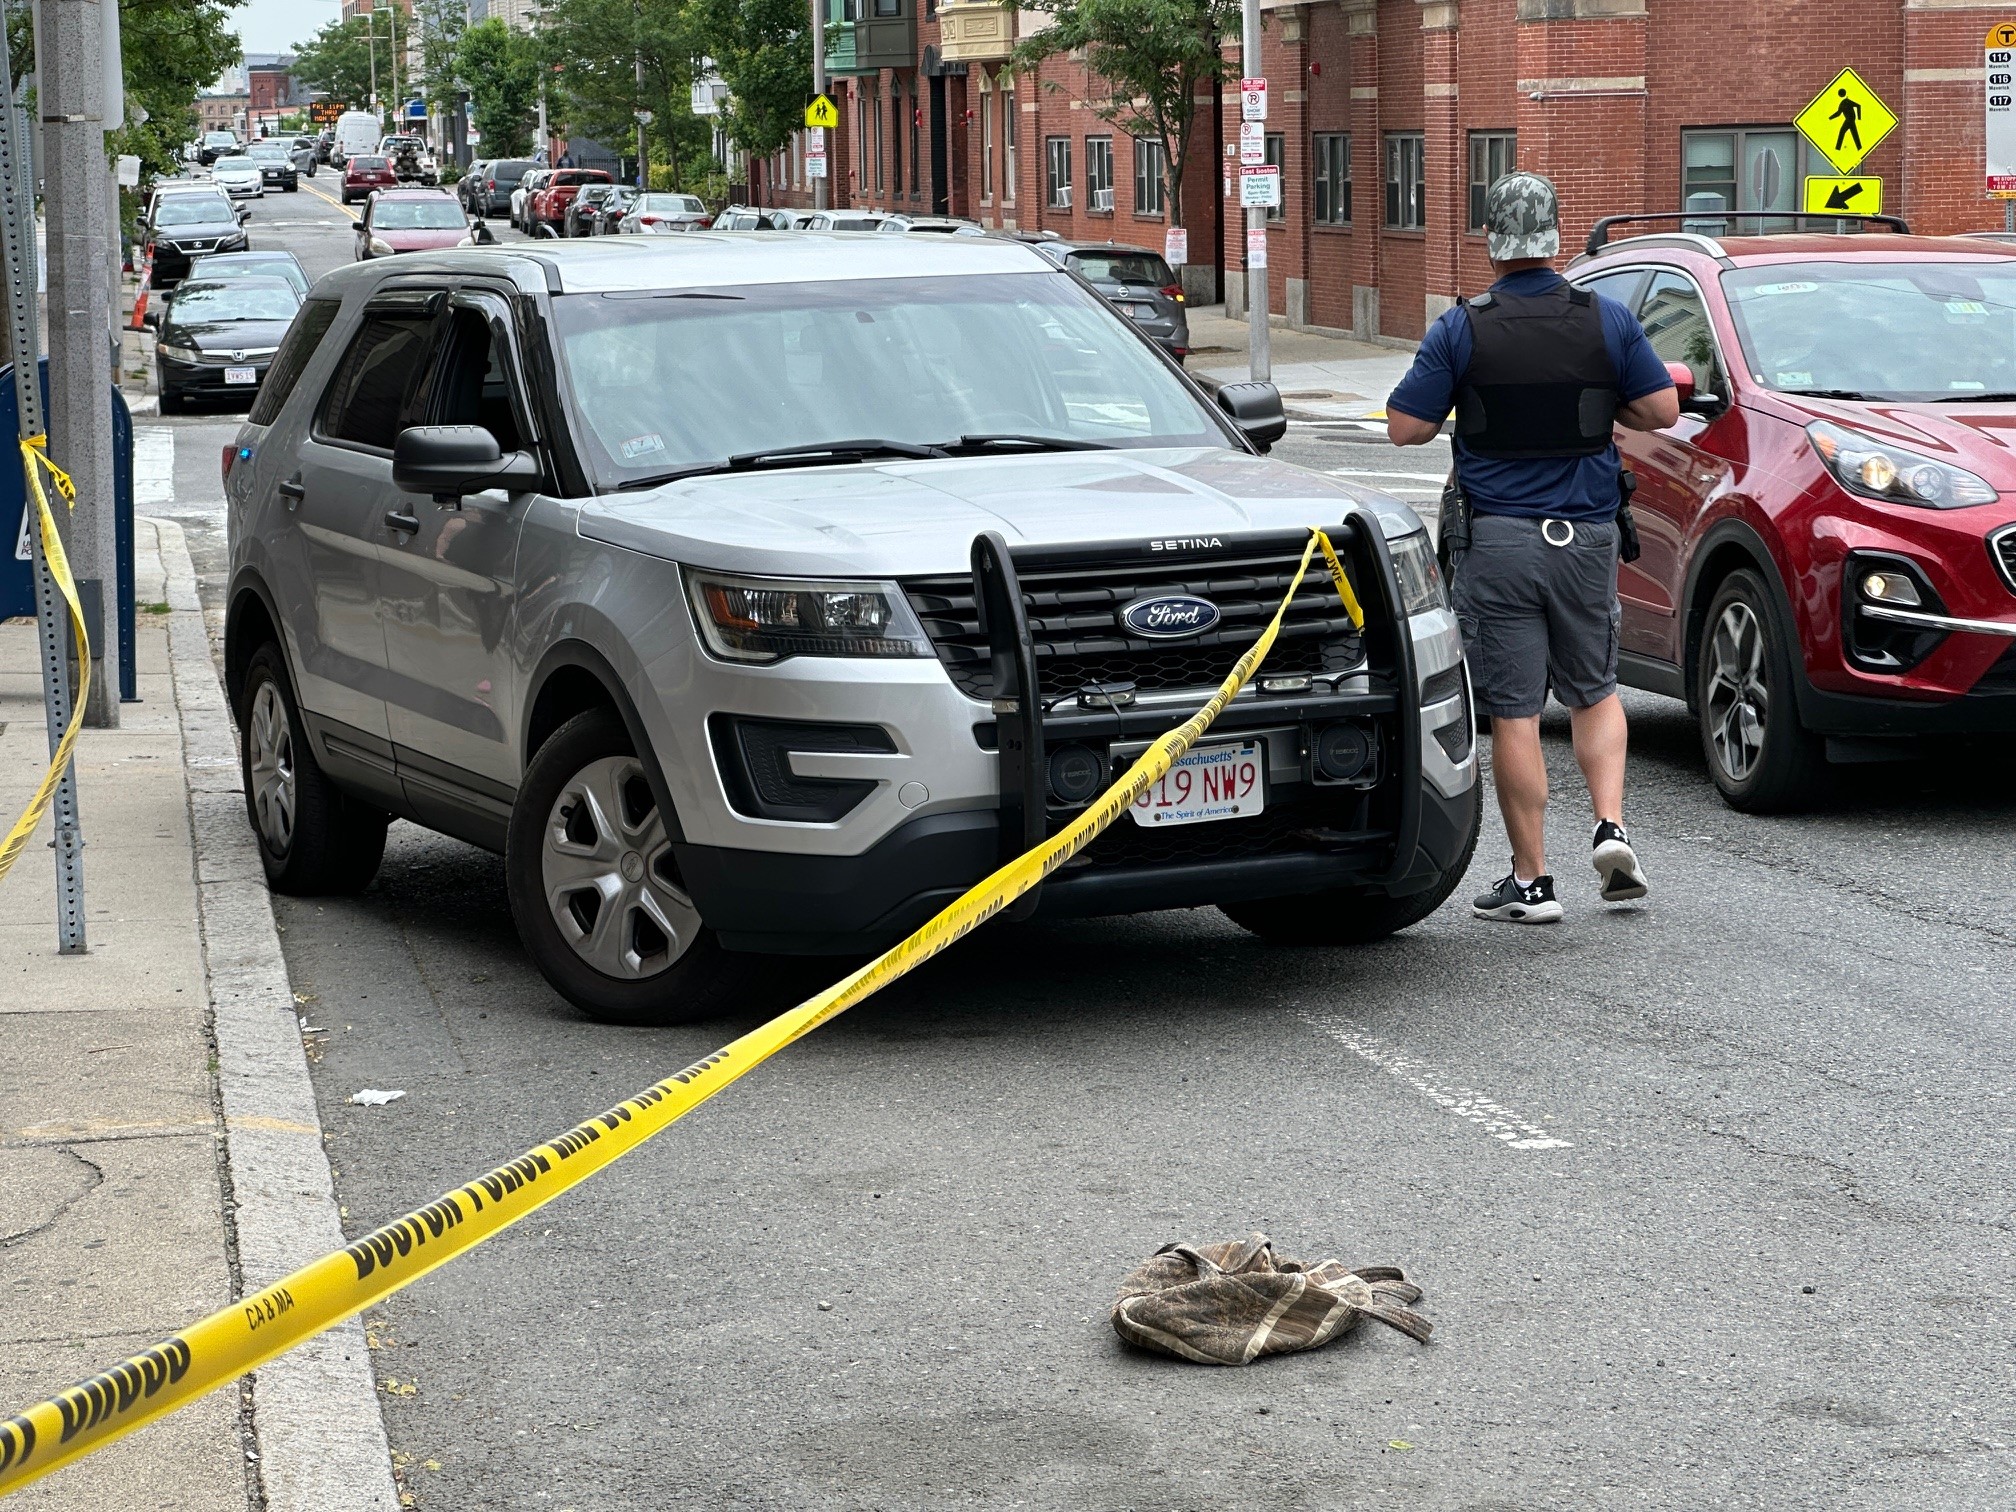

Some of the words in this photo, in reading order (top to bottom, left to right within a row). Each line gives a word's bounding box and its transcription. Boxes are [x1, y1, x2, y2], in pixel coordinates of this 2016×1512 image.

[1992, 53, 2008, 62] 114
[1992, 75, 2009, 83] 116
[1992, 96, 2009, 105] 117
[1151, 537, 1222, 551] SETINA
[1147, 603, 1199, 627] Ford
[1203, 762, 1255, 803] NW9
[1161, 811, 1174, 820] The
[1176, 809, 1195, 819] Spirit
[1197, 809, 1203, 817] of
[245, 1304, 265, 1331] CA
[262, 1298, 275, 1320] &
[271, 1288, 294, 1315] MA
